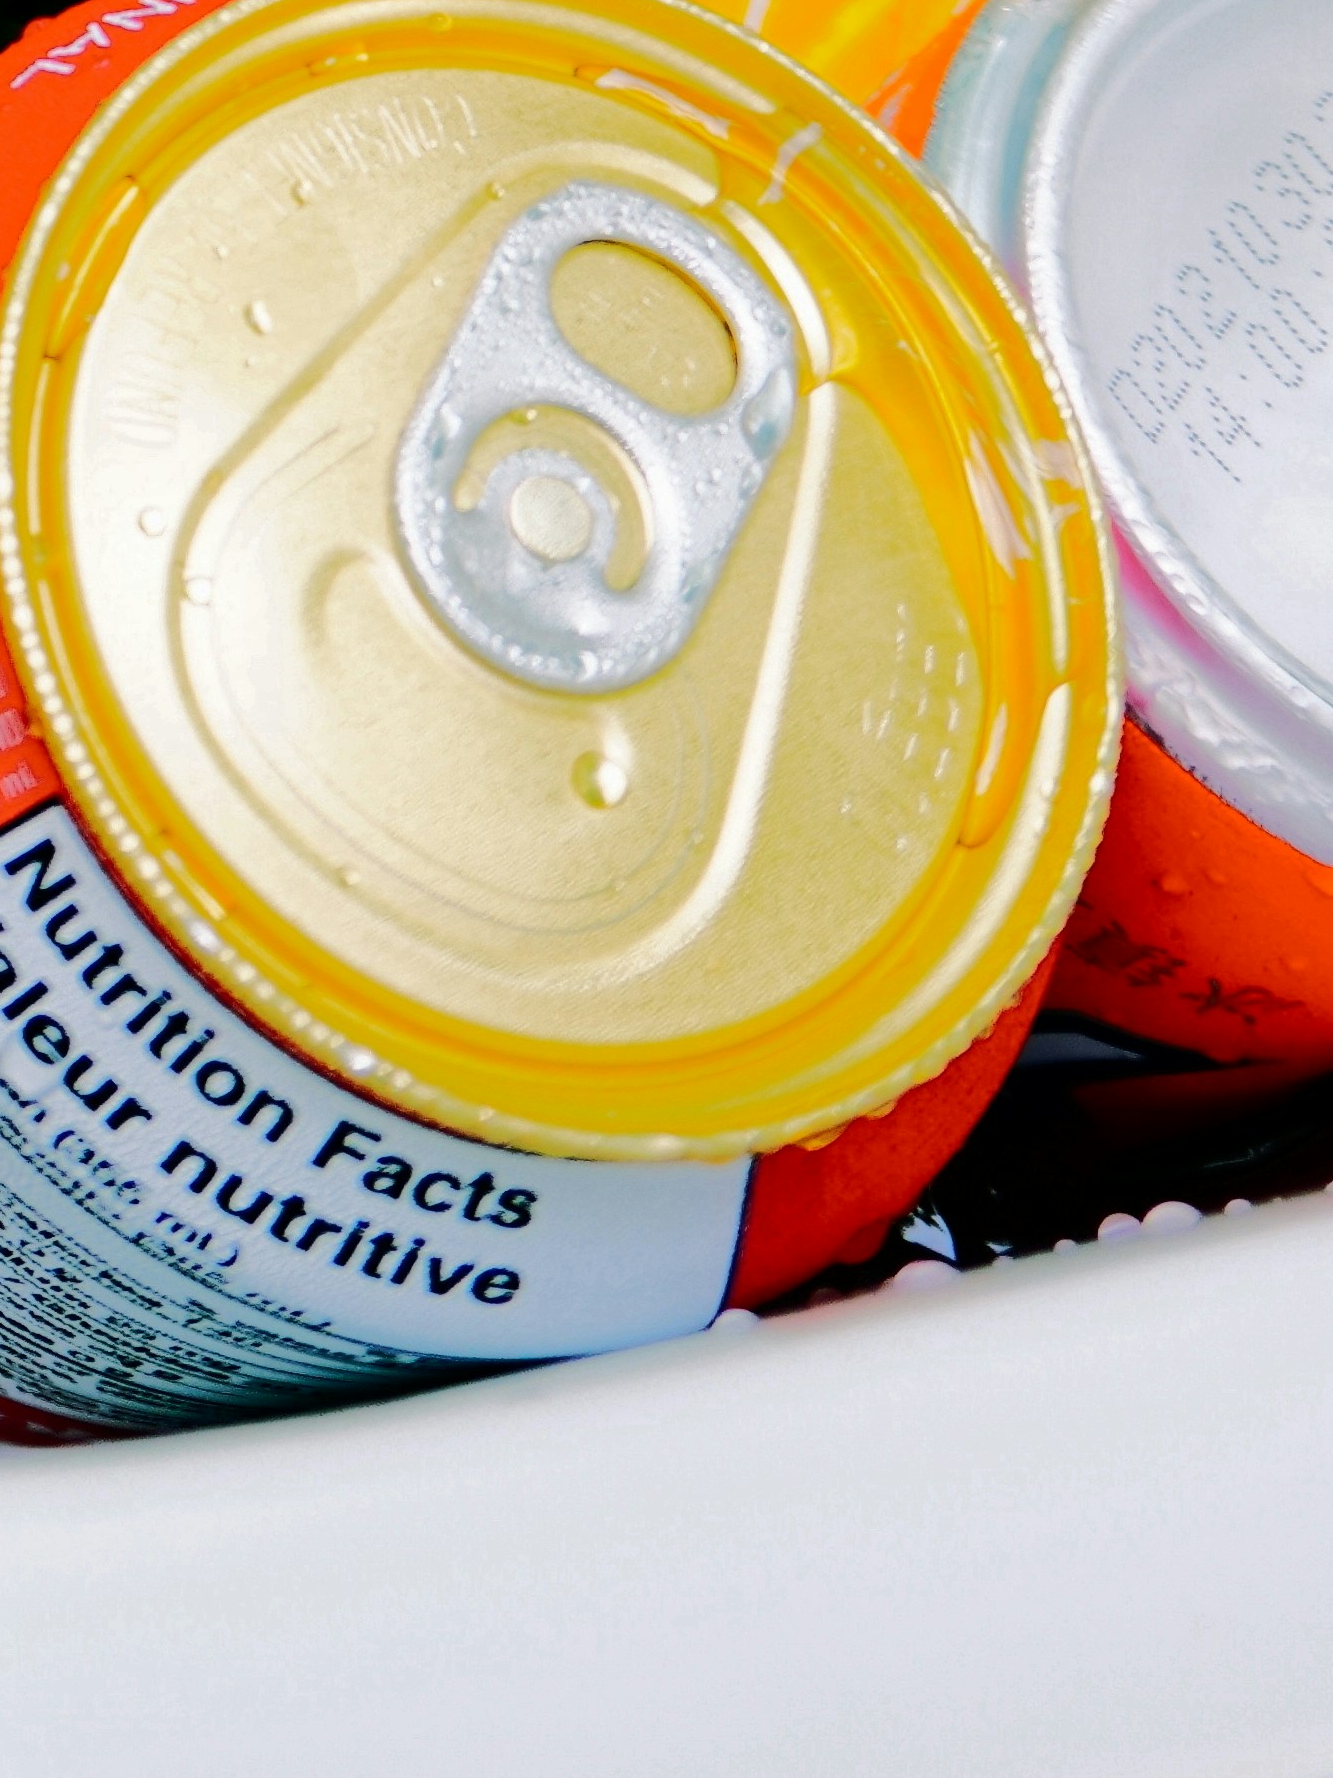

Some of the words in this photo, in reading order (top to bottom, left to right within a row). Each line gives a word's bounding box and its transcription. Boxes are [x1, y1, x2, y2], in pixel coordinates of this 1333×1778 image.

[3, 837, 297, 1143] Nutrition
[310, 1120, 541, 1232] Facts
[159, 1135, 522, 1306] nutritive
